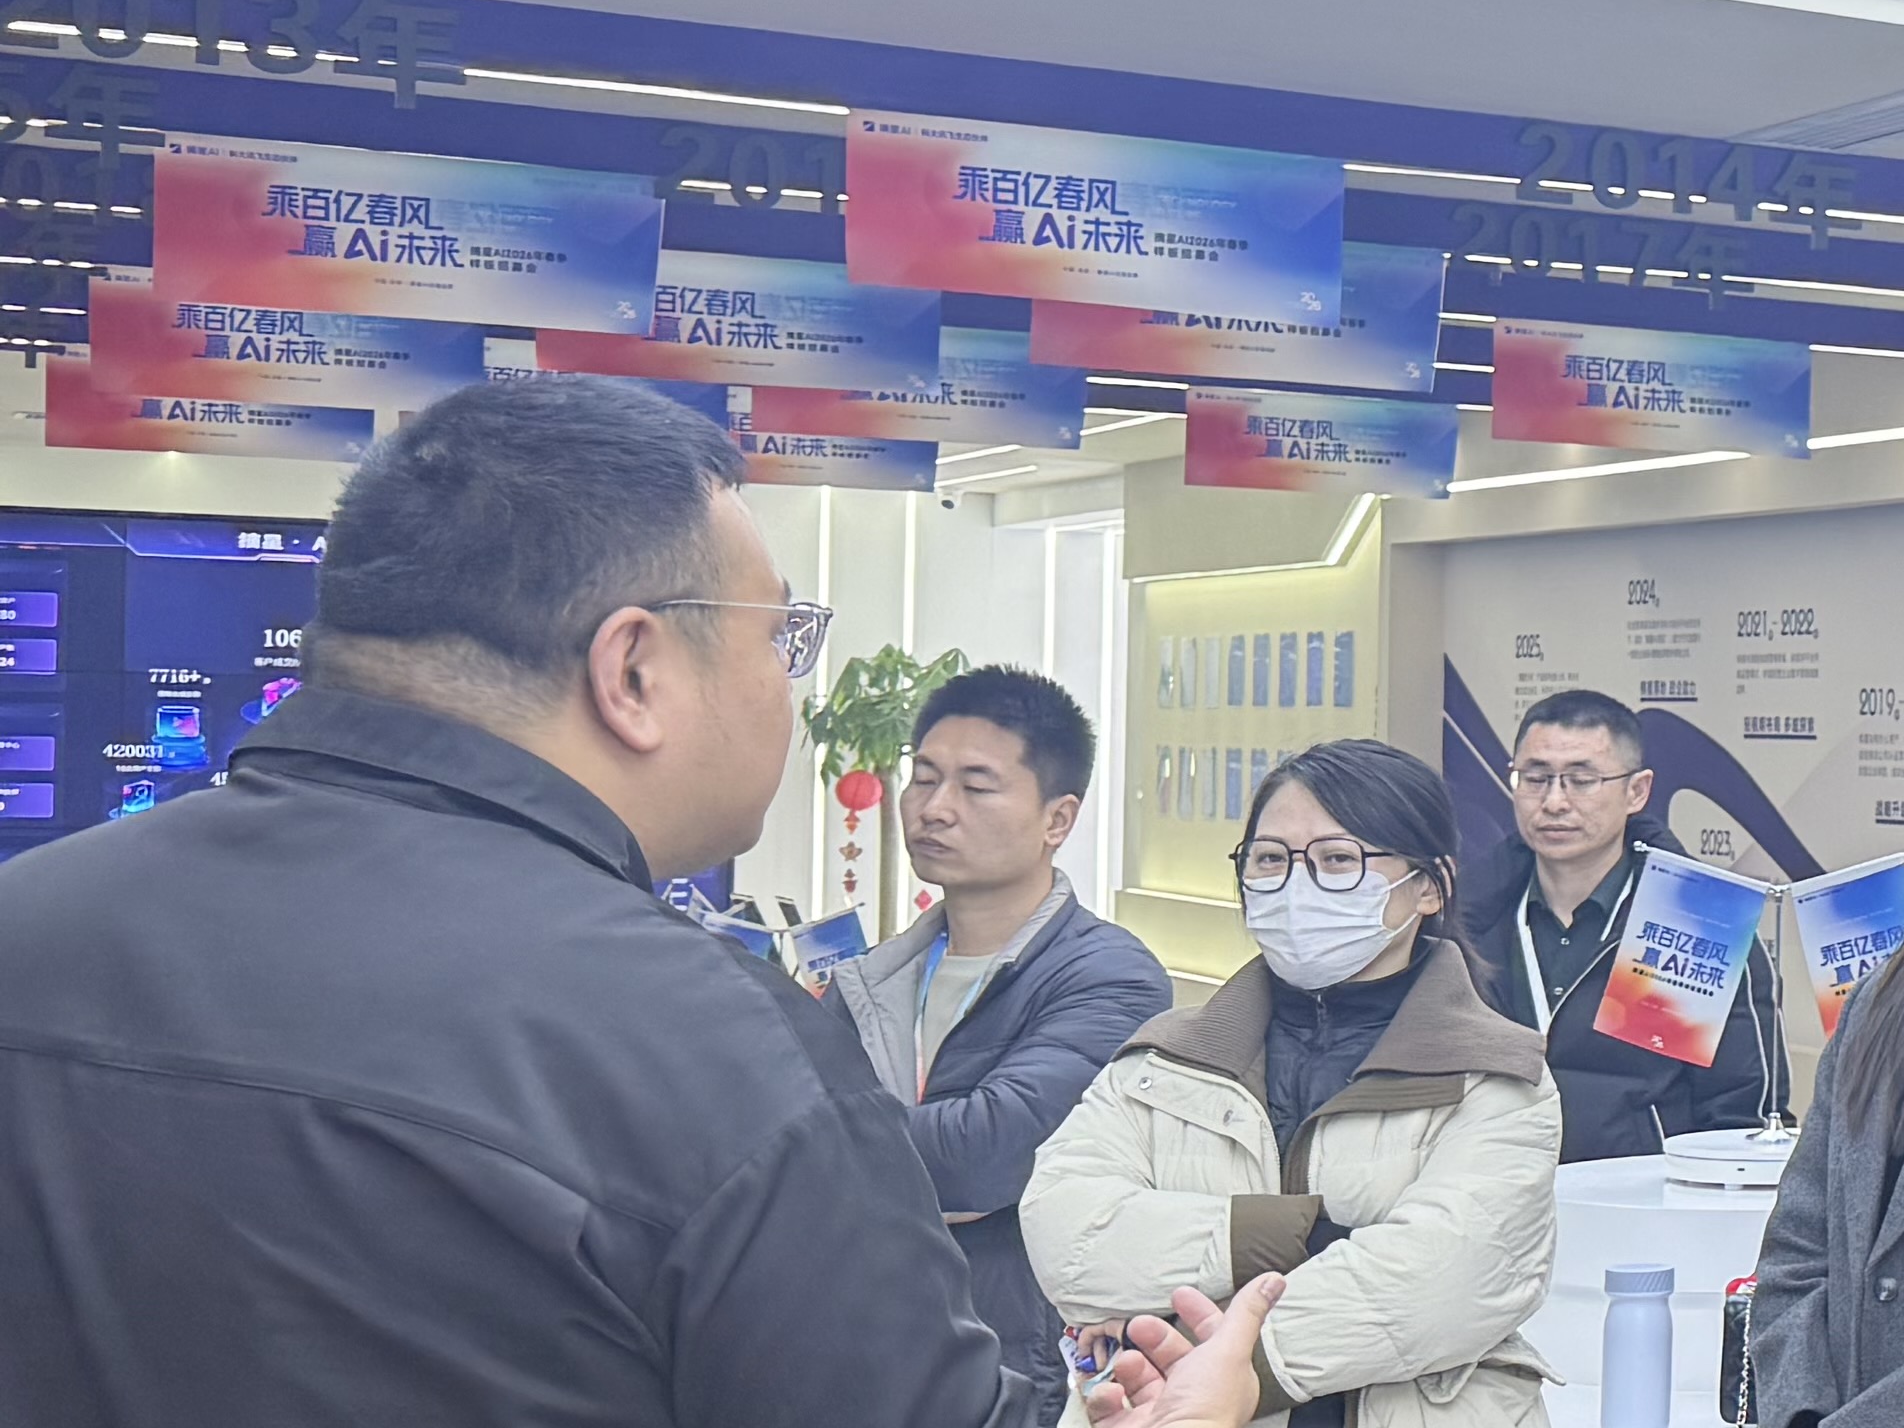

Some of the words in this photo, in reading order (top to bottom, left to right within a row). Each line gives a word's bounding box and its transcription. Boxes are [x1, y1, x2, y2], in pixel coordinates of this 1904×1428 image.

[261, 184, 444, 231] 乘百亿春风
[952, 166, 1130, 216] 乘百亿春风
[1515, 122, 1863, 250] 2014年
[171, 304, 314, 338] 乘百亿春风
[1560, 355, 1673, 387] 乘百亿春风
[1636, 921, 1730, 966] 乘百亿春风
